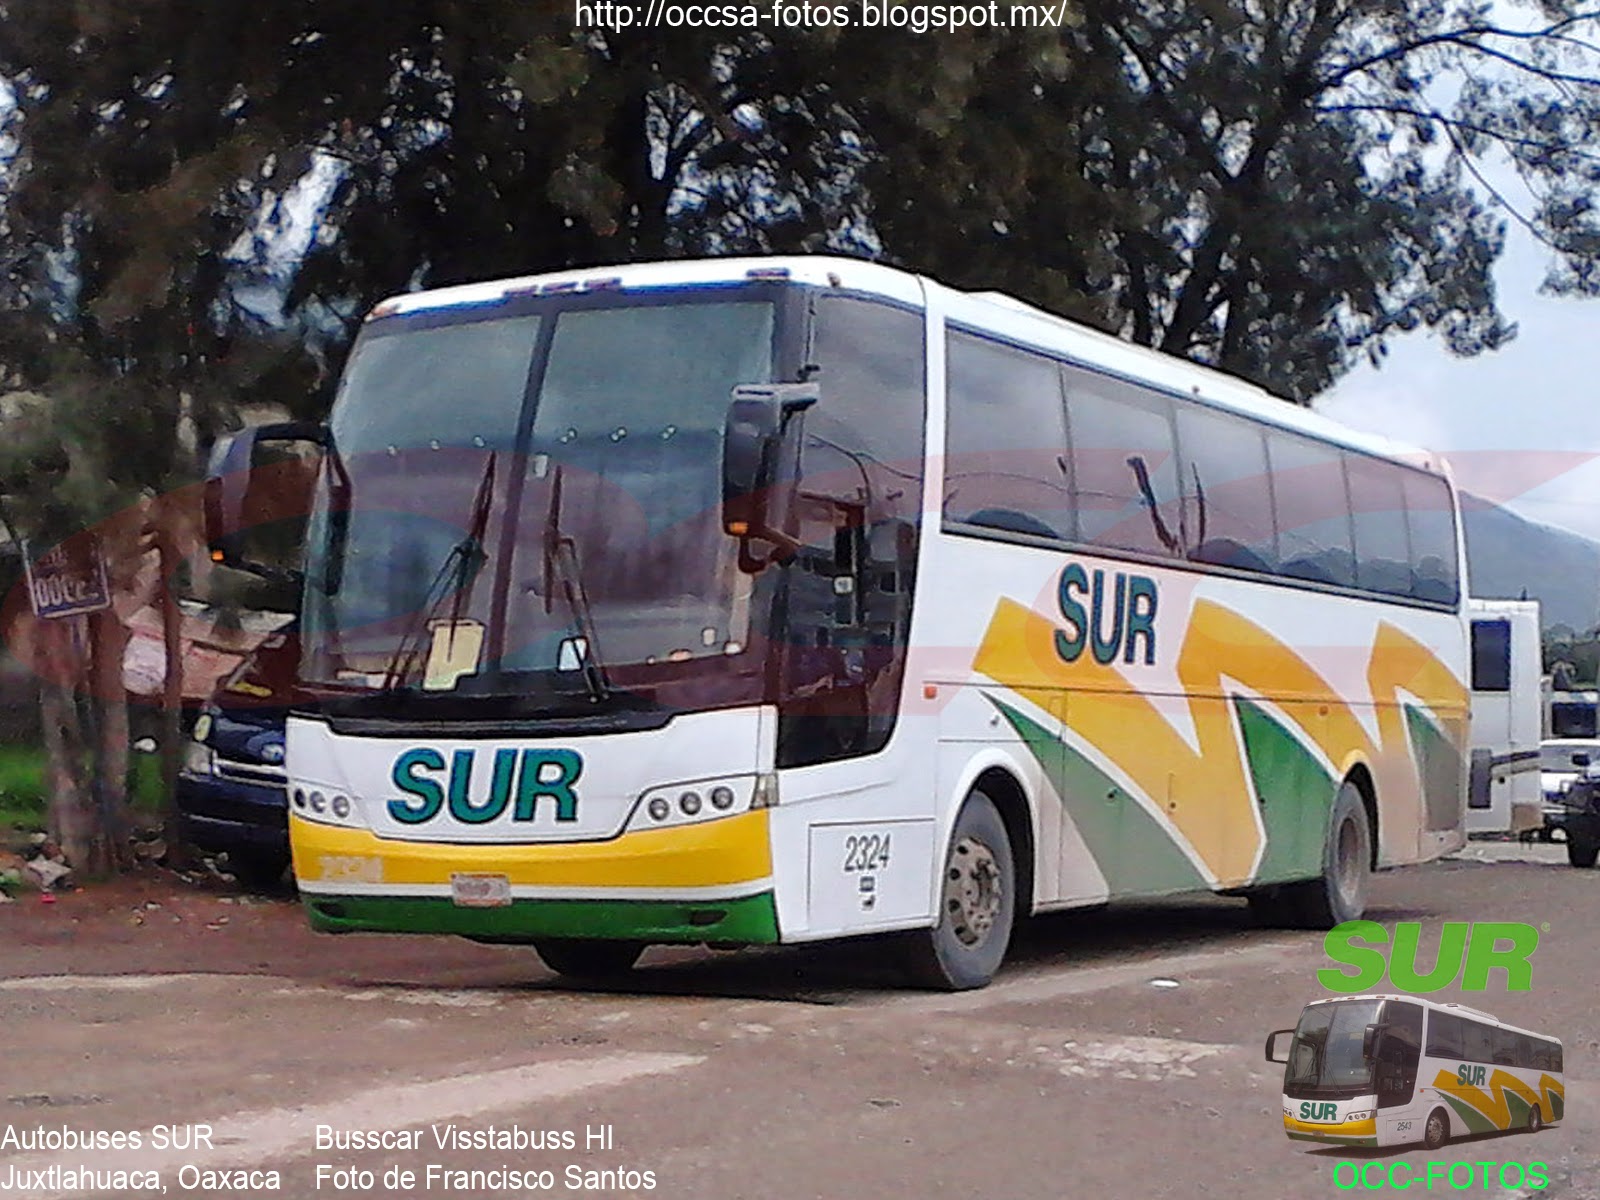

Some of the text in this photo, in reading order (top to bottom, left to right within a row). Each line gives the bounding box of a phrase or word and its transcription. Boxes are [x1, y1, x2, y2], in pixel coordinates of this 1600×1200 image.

[1054, 562, 1158, 666] SUR
[387, 747, 584, 824] SUR
[844, 833, 891, 872] 2324
